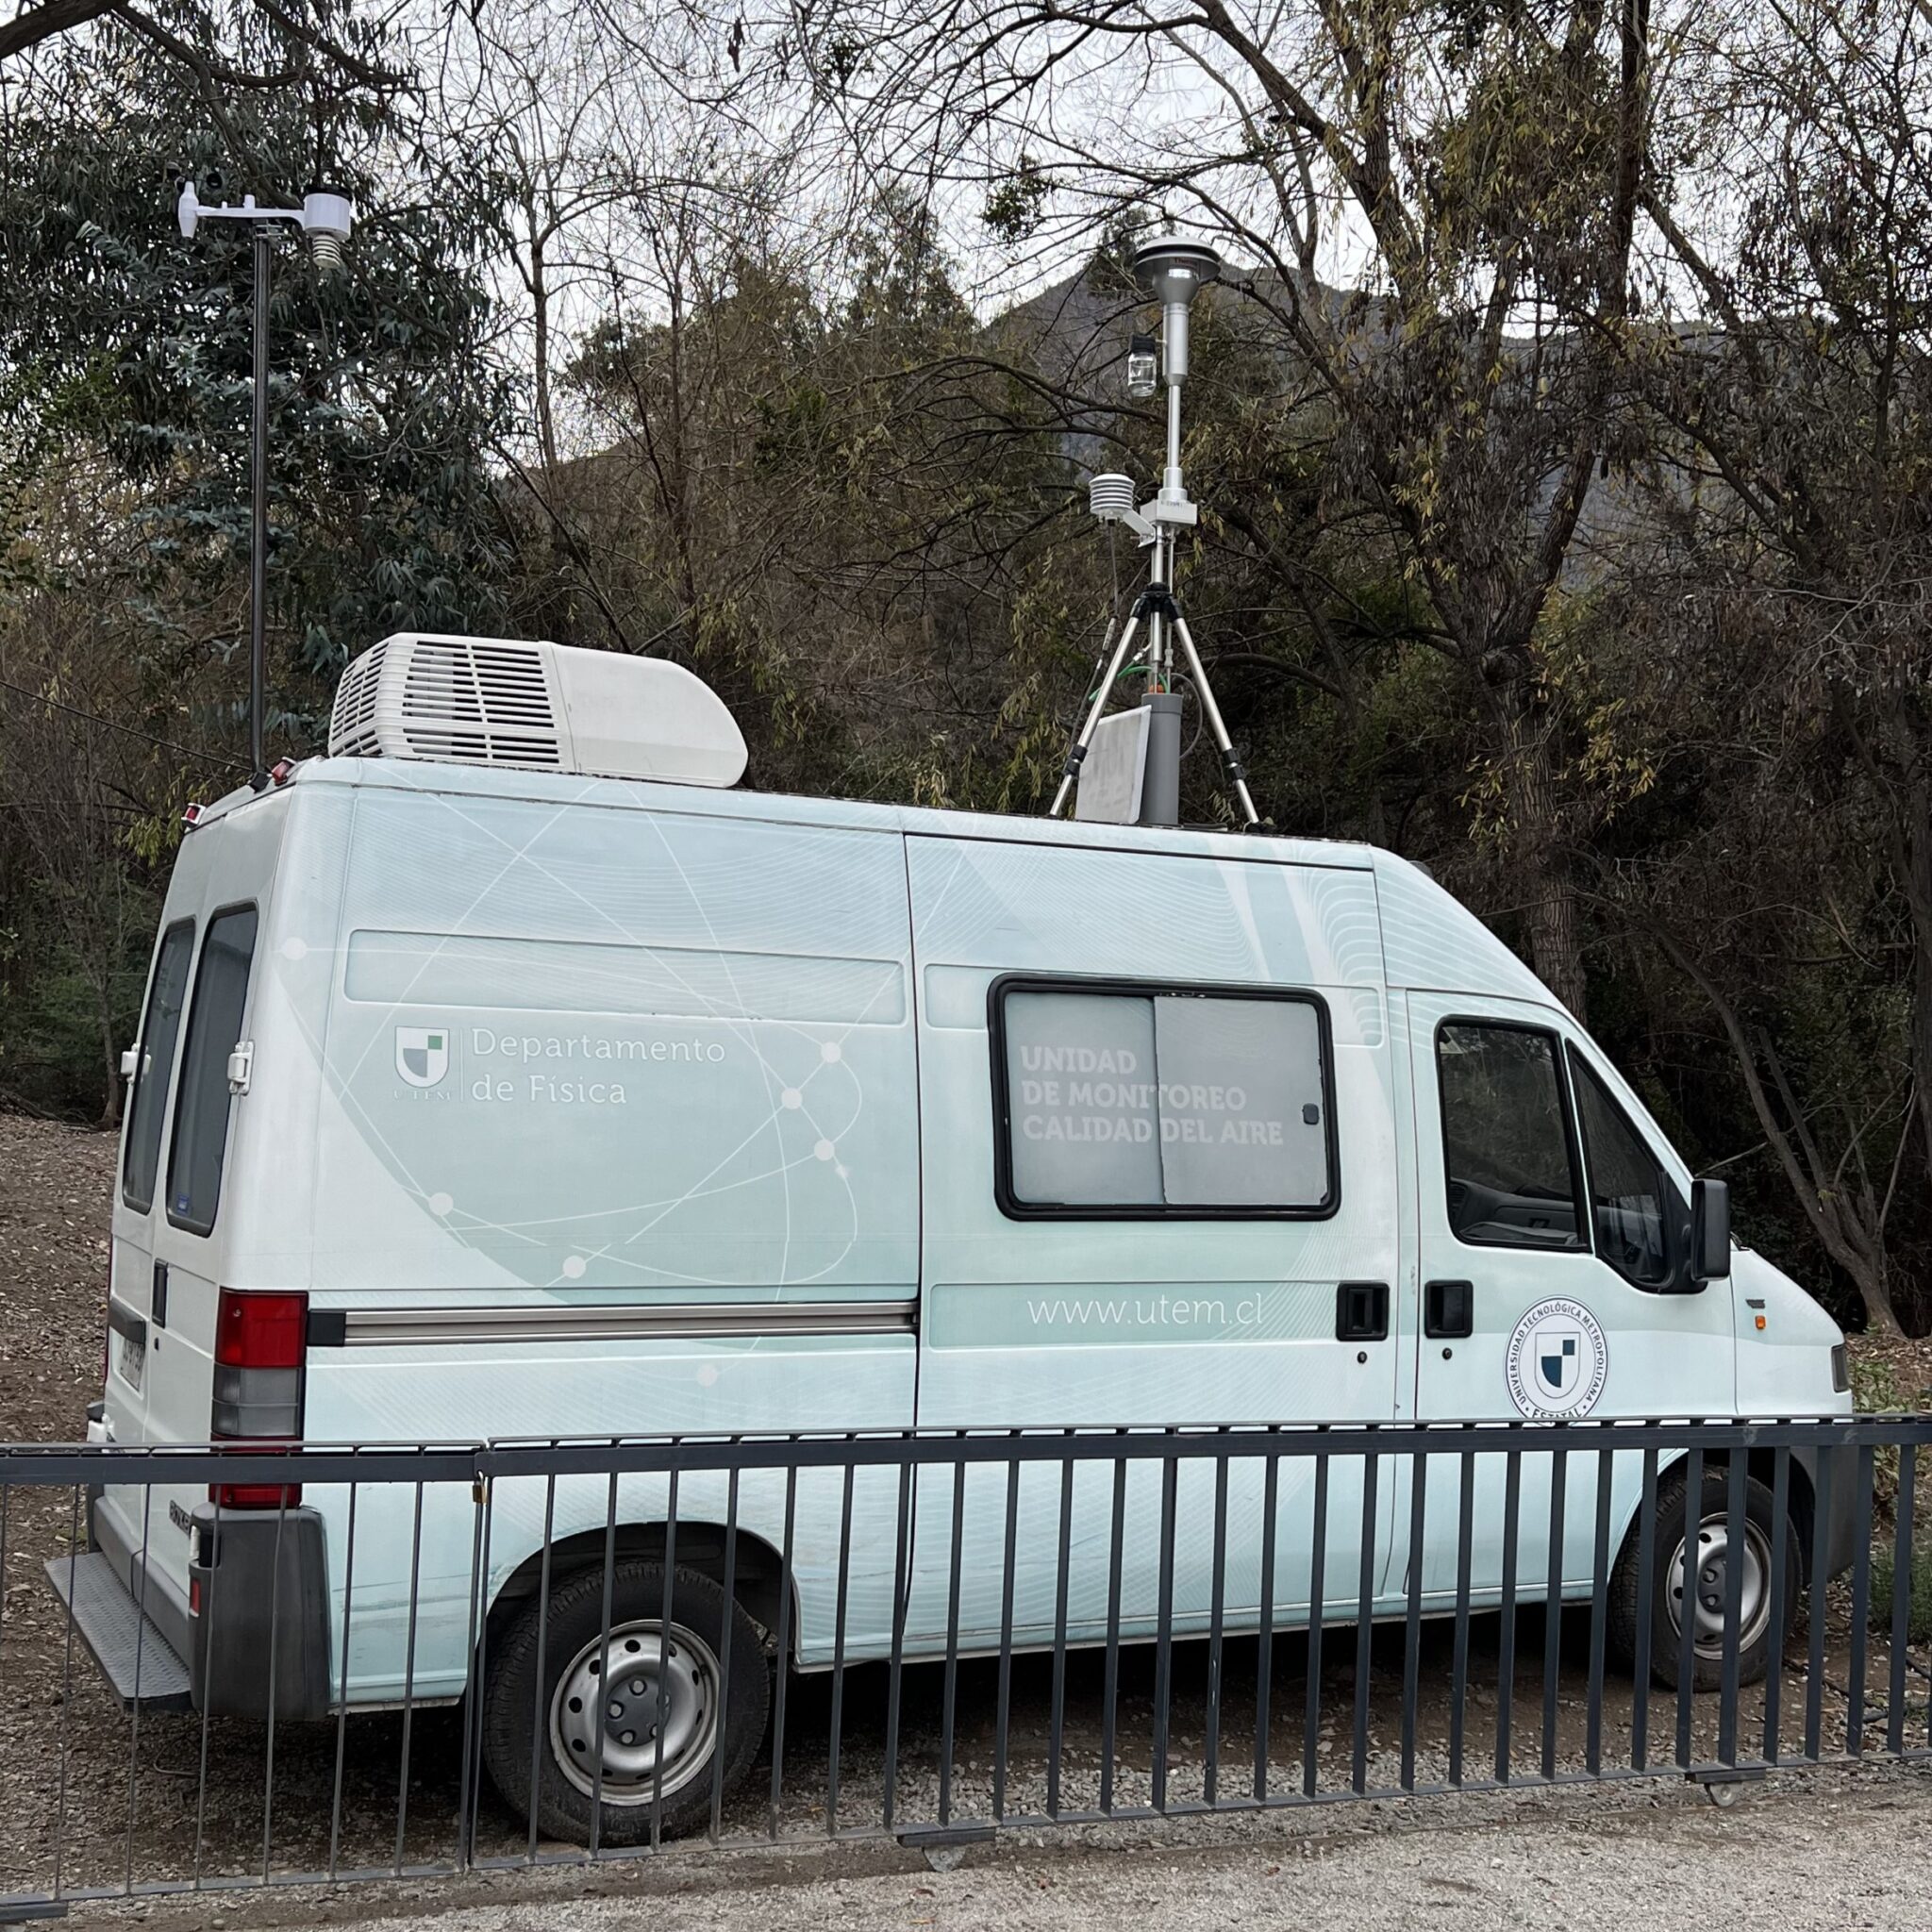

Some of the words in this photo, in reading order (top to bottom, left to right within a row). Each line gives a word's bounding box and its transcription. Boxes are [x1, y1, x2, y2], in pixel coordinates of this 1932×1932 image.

[472, 1027, 725, 1063] Departamento
[1020, 1045, 1138, 1074] UNIDAD
[472, 1074, 514, 1101] de
[529, 1074, 627, 1104] Física
[1022, 1080, 1060, 1107] DE
[1068, 1082, 1247, 1111] MONITOREO
[1022, 1114, 1153, 1143] CALIDAD
[1159, 1120, 1214, 1144] DEL
[1220, 1120, 1284, 1145] AIRE
[1026, 1292, 1263, 1324] www.utem.cl
[1509, 1329, 1526, 1406] UNIVERSIDAD
[1523, 1301, 1582, 1329] TECNOLÓGICA
[1582, 1314, 1605, 1403] METROPOLITANA
